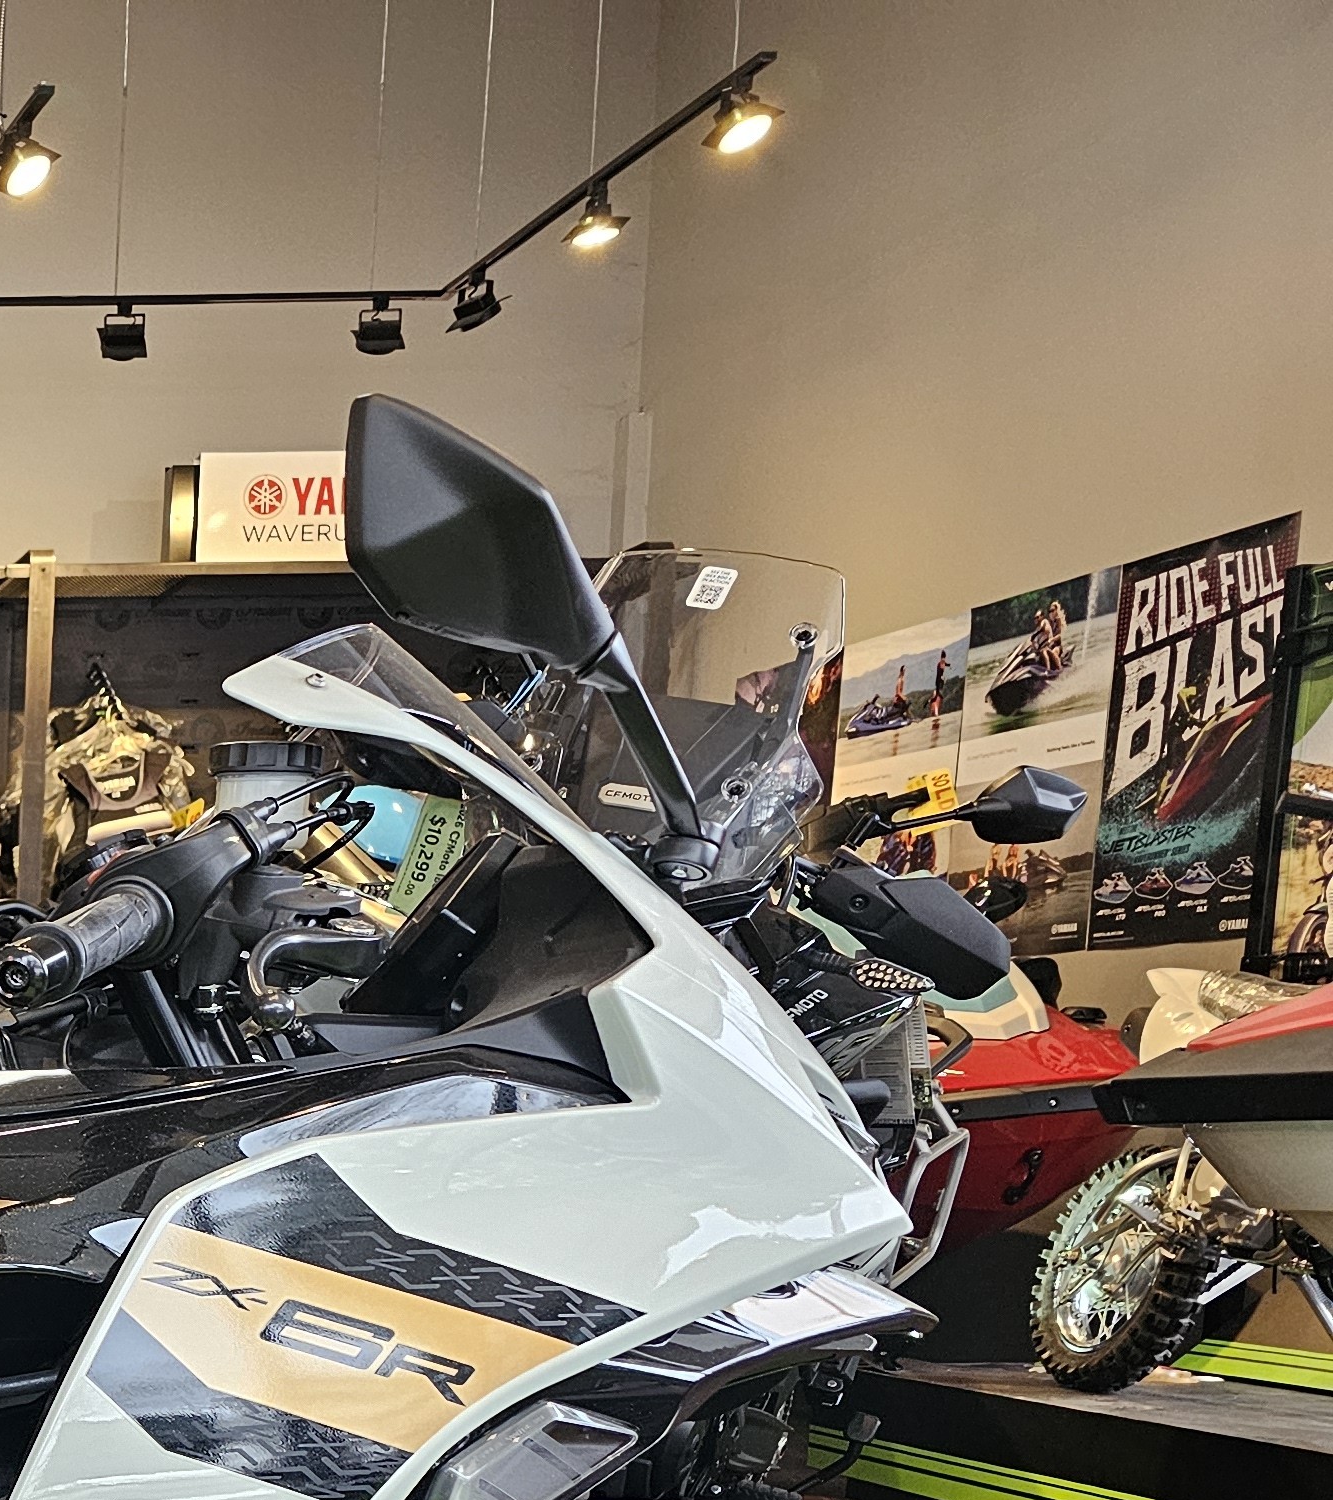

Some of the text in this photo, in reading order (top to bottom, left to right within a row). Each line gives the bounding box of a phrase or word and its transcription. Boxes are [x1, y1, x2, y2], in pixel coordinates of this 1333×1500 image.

[292, 477, 346, 515] YA
[1123, 544, 1285, 656] RIDE FULL
[1107, 595, 1284, 800] BLAST
[932, 773, 956, 810] SOLD
[1103, 825, 1196, 854] JETBLASTER
